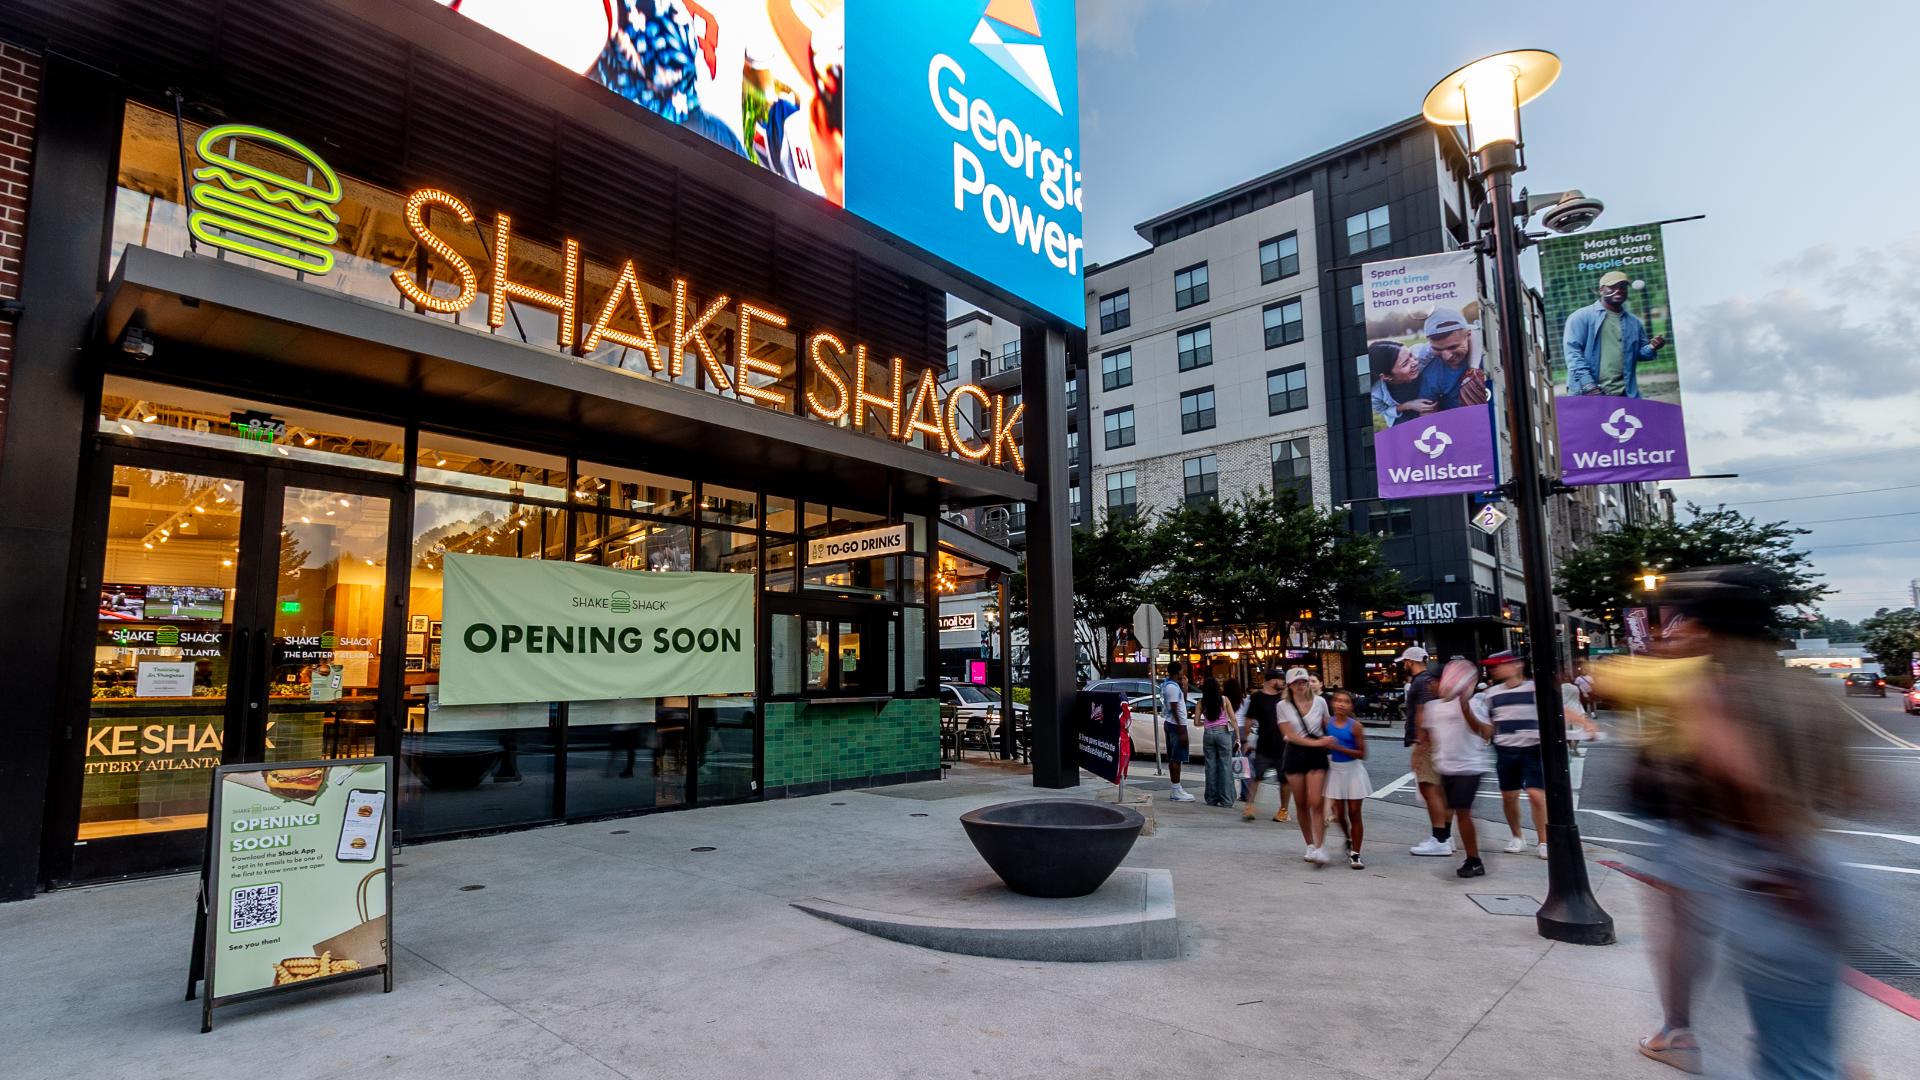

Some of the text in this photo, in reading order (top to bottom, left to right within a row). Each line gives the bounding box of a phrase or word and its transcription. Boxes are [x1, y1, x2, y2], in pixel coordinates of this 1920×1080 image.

[953, 141, 1084, 276] Power
[1584, 233, 1651, 249] More than
[1581, 244, 1656, 260] healthcare.
[1578, 255, 1657, 271] PeopleCare.
[1371, 266, 1406, 279] Spend
[1371, 274, 1430, 288] more time
[1372, 288, 1404, 299] being
[1416, 281, 1456, 293] person
[1373, 297, 1399, 308] than
[1412, 290, 1458, 304] patient.
[390, 188, 1026, 473] SHAKE SHACK
[249, 418, 286, 437] 874
[1572, 448, 1676, 469] Wellstar
[1388, 463, 1482, 483] Wellstar
[1484, 512, 1495, 526] 2
[826, 534, 901, 556] TO-GO DRINKS
[572, 597, 666, 611] SHAKE SHACK
[943, 616, 957, 627] nail
[958, 616, 973, 626] bar
[112, 630, 222, 643] SHAKE SHACK
[284, 637, 373, 646] SHAKE SHACK
[463, 622, 741, 654] OPENING SOON
[135, 647, 180, 656] BATTERY
[180, 648, 221, 657] ATLANTA
[302, 651, 337, 659] BATTERY
[145, 757, 221, 772] ATLANTA
[233, 813, 318, 832] OPENING
[232, 834, 288, 852] SOON
[232, 853, 266, 862] Download
[278, 849, 299, 857] Shack
[301, 847, 316, 856] App
[265, 857, 285, 866] emails
[242, 869, 255, 877] first
[264, 866, 281, 874] know
[244, 941, 260, 949] you
[261, 937, 281, 945] then!
